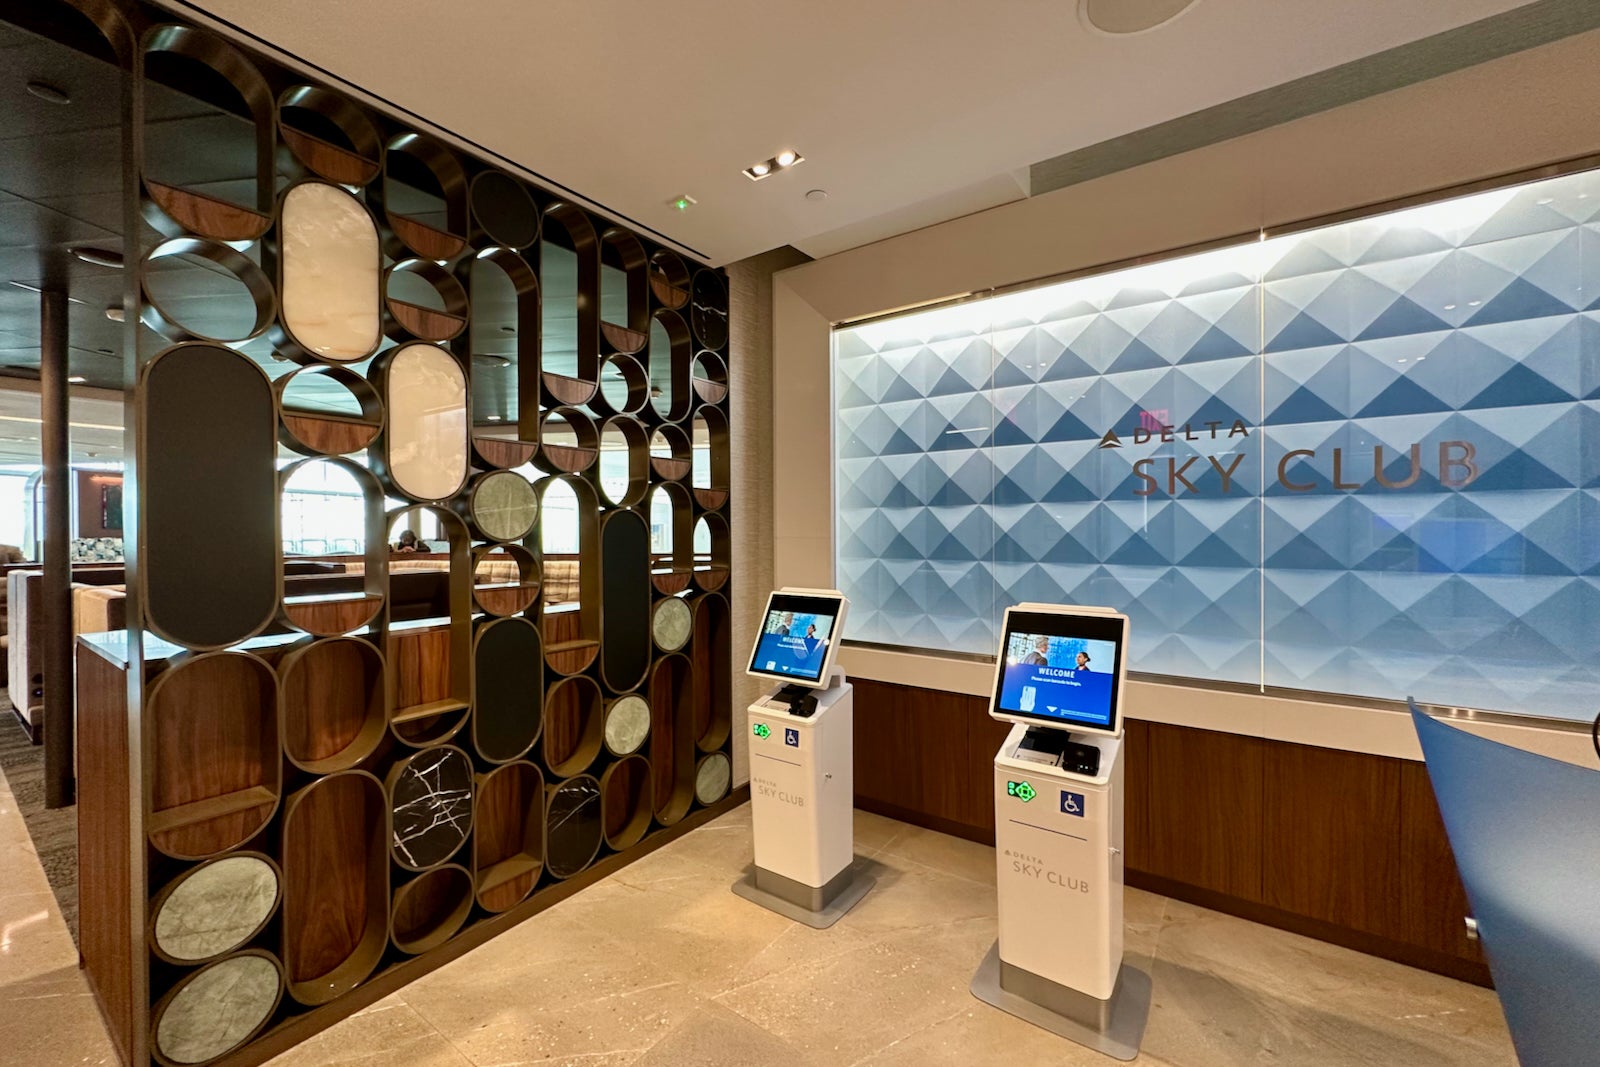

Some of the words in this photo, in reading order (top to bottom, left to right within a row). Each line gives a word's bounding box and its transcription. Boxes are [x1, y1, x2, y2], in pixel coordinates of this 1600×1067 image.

[1133, 419, 1249, 445] DELTA
[1133, 453, 1245, 496] SKY
[1277, 441, 1478, 492] CLUB
[1038, 667, 1075, 679] WELCOME
[758, 785, 777, 798] SKY
[778, 791, 804, 807] CLUB
[1012, 861, 1042, 878] SKY
[1046, 871, 1089, 893] CLUB
